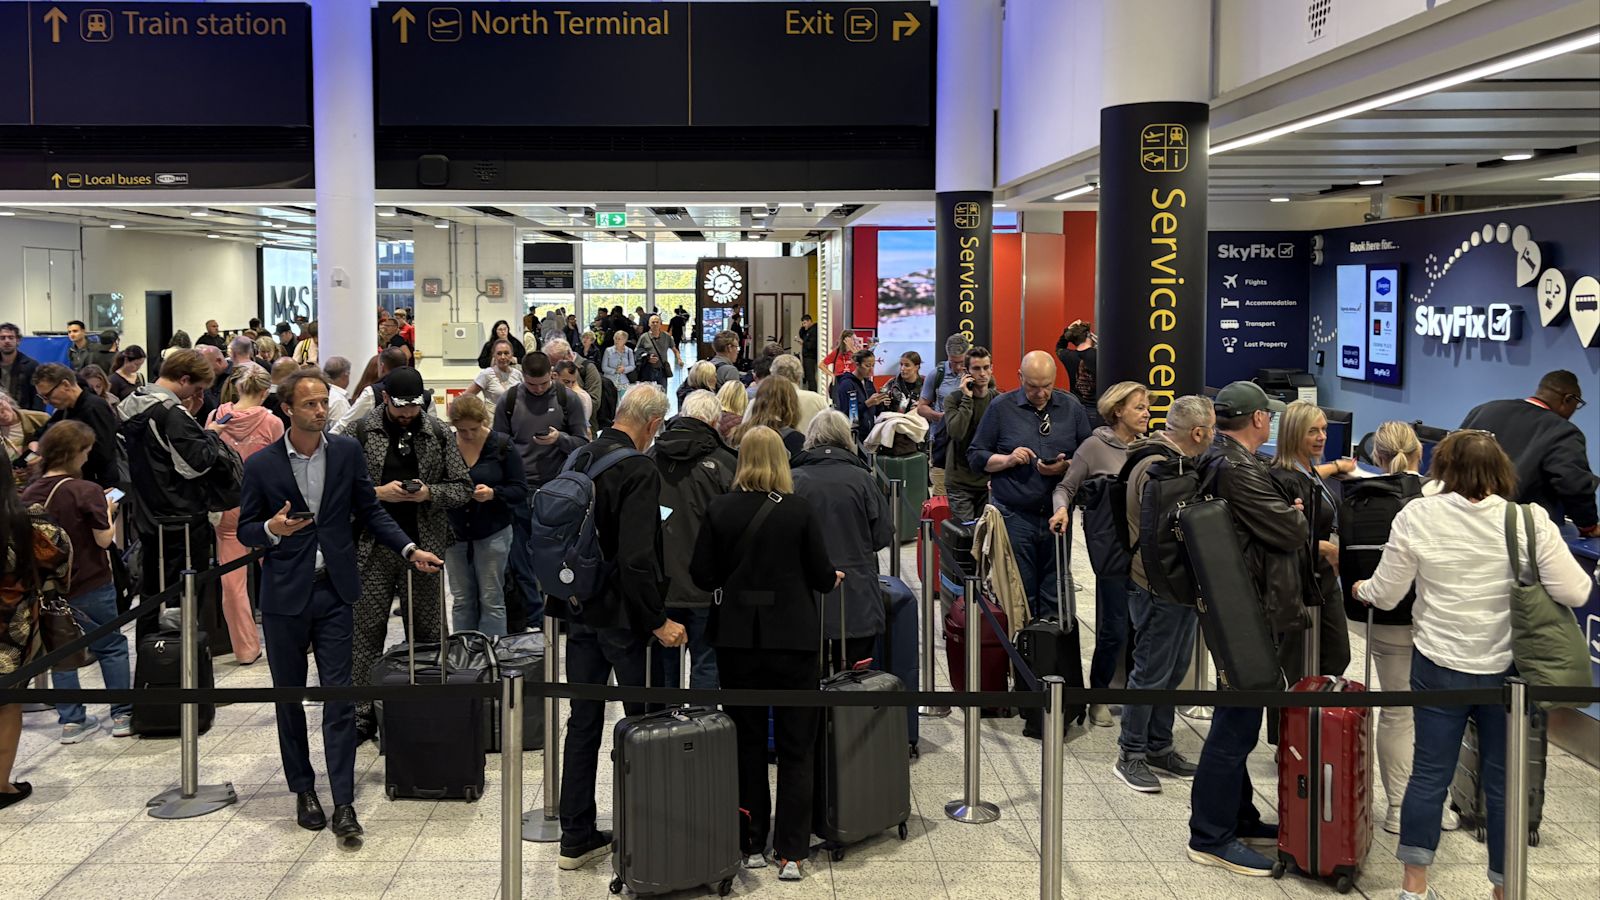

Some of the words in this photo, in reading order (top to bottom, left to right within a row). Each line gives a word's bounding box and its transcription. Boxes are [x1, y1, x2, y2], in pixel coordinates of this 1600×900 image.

[122, 11, 188, 35] Train
[196, 12, 286, 35] station
[471, 10, 549, 35] North
[555, 10, 669, 36] Terminal
[786, 9, 833, 35] Exit
[85, 174, 115, 185] Local
[118, 174, 151, 185] buses
[1217, 243, 1276, 262] SkyFix
[1350, 241, 1366, 252] Book
[1366, 240, 1380, 251] here
[1149, 188, 1187, 332] Service
[959, 235, 980, 314] Service
[1244, 278, 1268, 288] Flights
[270, 285, 311, 327] M&S
[1244, 299, 1298, 307] Accommodation
[1244, 320, 1276, 329] Transport
[1415, 304, 1486, 345] SkyFix
[1259, 341, 1288, 350] Property
